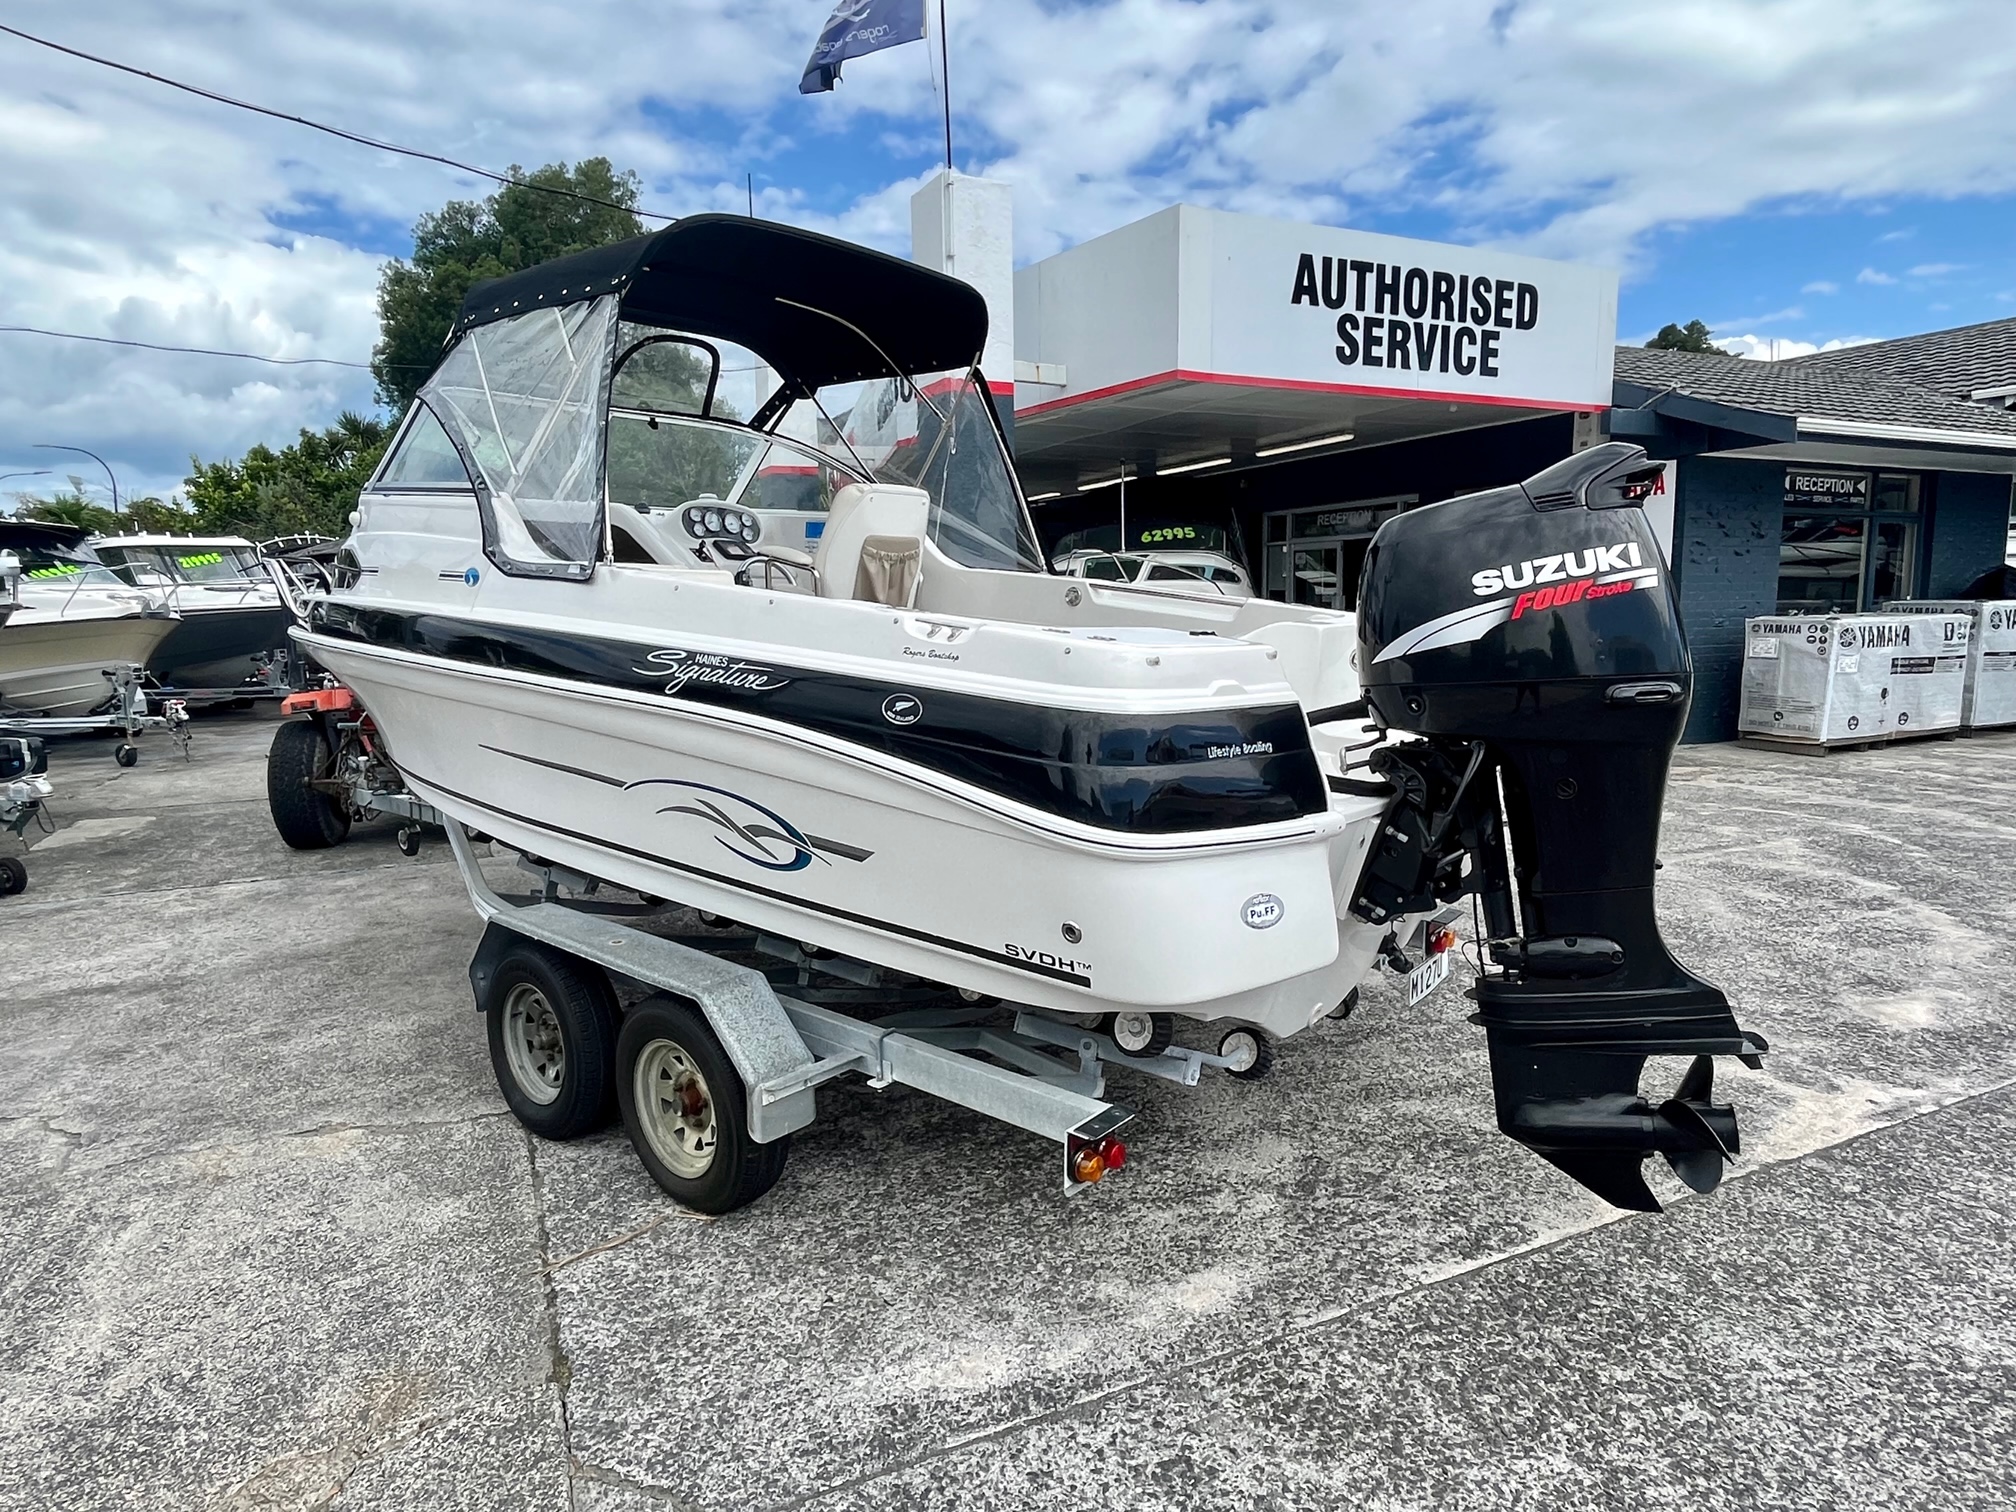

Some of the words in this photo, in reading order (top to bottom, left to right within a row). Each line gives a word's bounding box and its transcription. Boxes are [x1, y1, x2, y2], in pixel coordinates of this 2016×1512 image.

[1291, 253, 1539, 330] AUTHORISED
[1335, 313, 1501, 377] SERVICE
[1795, 476, 1854, 494] RECEPTION
[1317, 508, 1372, 526] RECEPTION
[1141, 526, 1196, 543] 62995
[1471, 542, 1642, 597] SUZUKI
[1763, 624, 1802, 634] YAMAHA
[1858, 624, 1911, 649] YAMAHA
[695, 653, 729, 668] HAINES
[632, 649, 790, 695] Signature
[1207, 744, 1242, 759] Lifestyle
